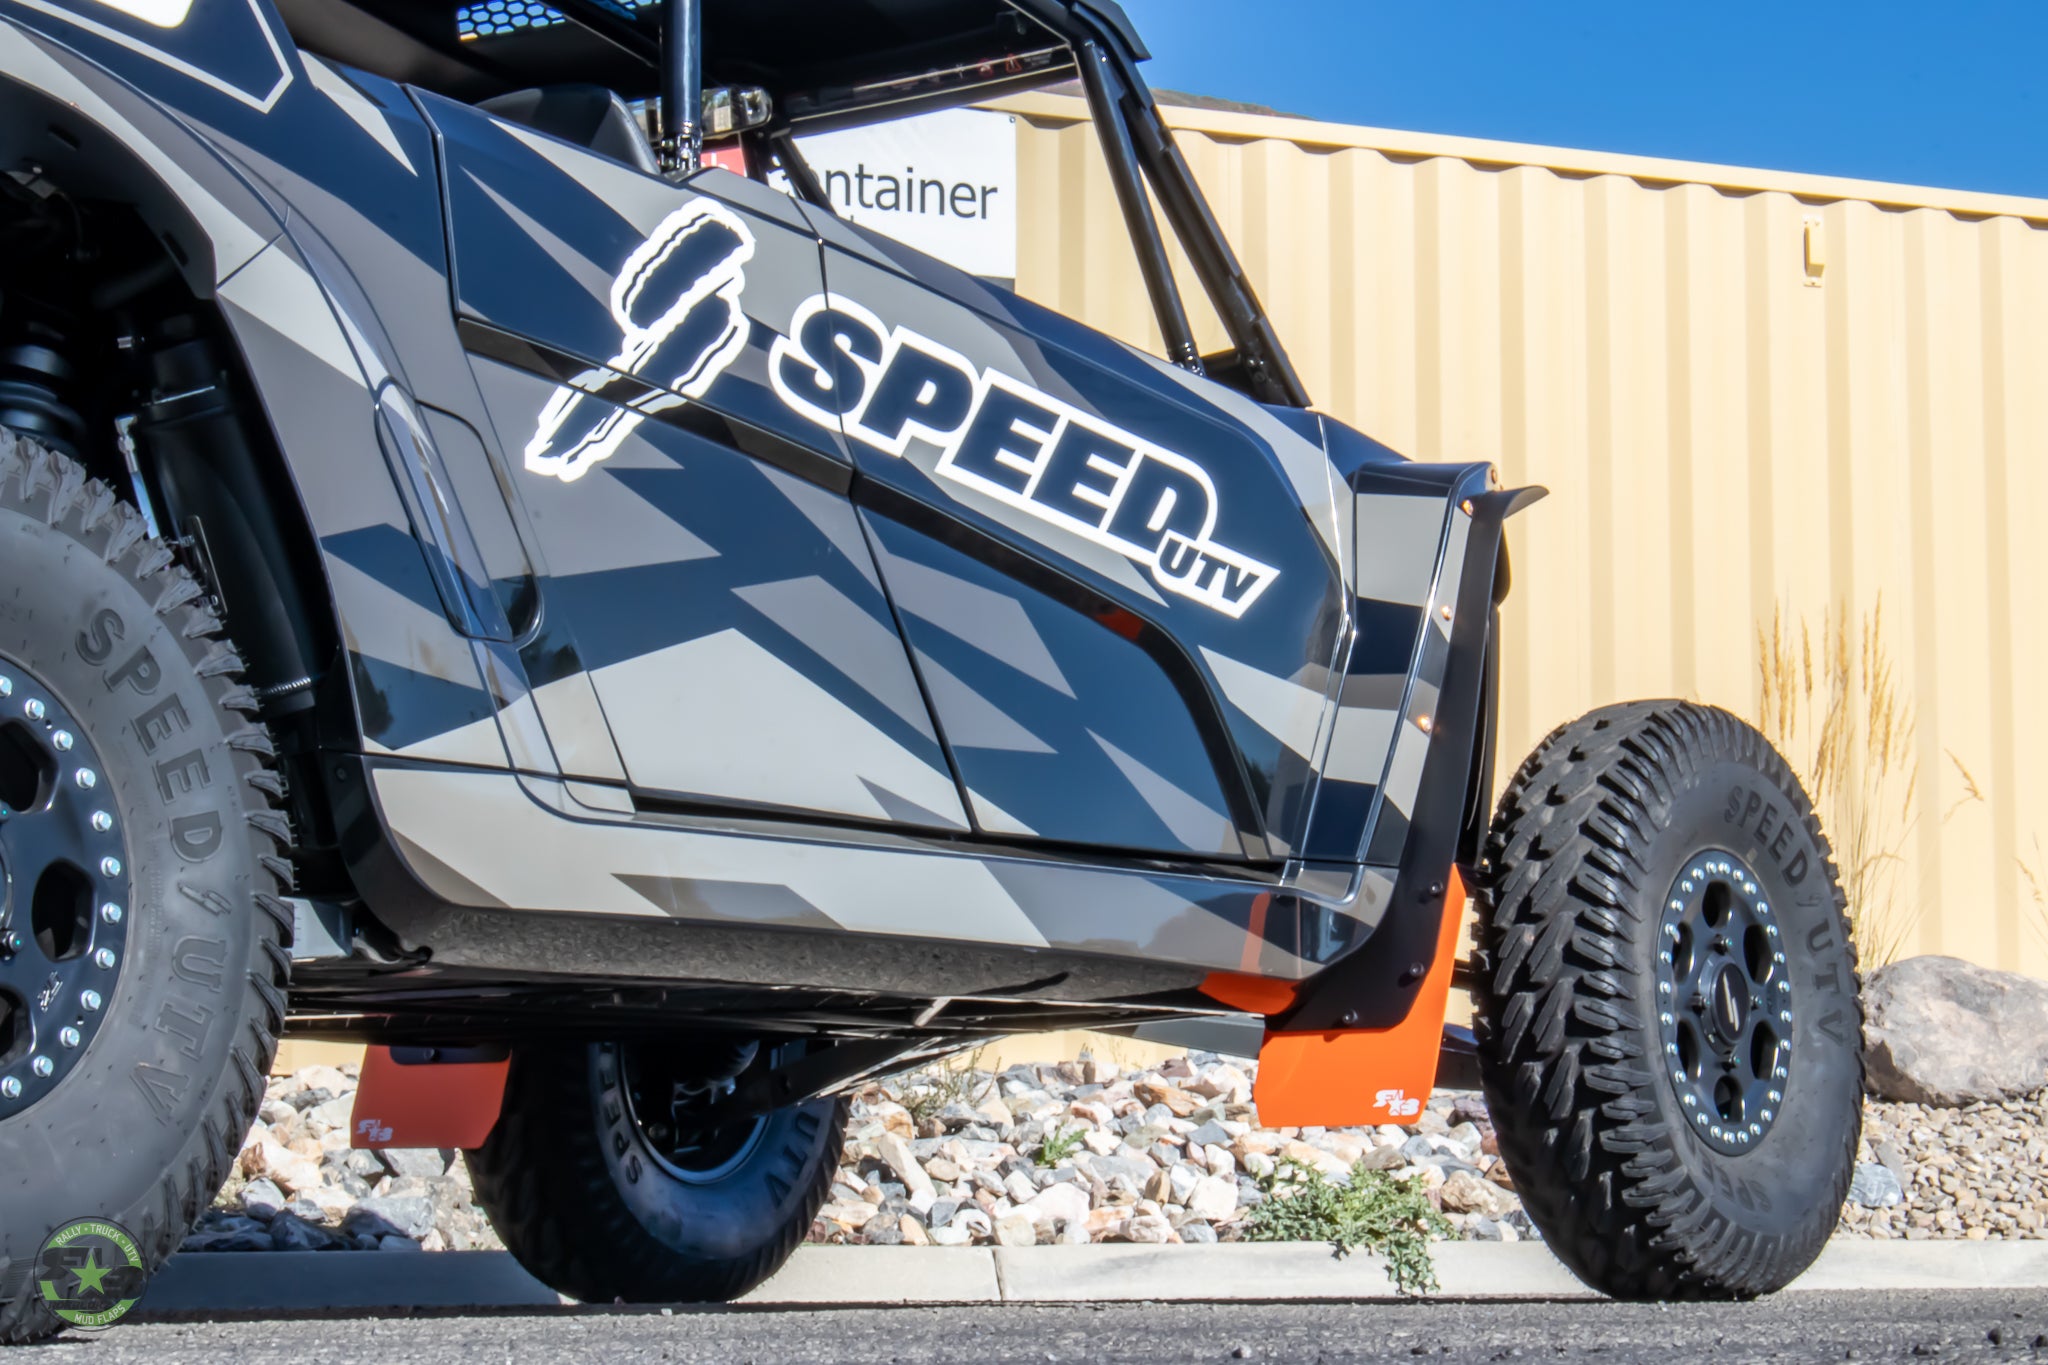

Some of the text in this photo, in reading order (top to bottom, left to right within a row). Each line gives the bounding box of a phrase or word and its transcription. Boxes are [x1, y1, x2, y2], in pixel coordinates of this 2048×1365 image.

[825, 163, 998, 220] ntainer
[776, 302, 1212, 558] SPEED
[1158, 536, 1260, 603] UTV
[74, 607, 228, 1127] SPEED UTV
[1723, 784, 1843, 1047] SPEED UTV
[764, 1110, 821, 1210] UTV
